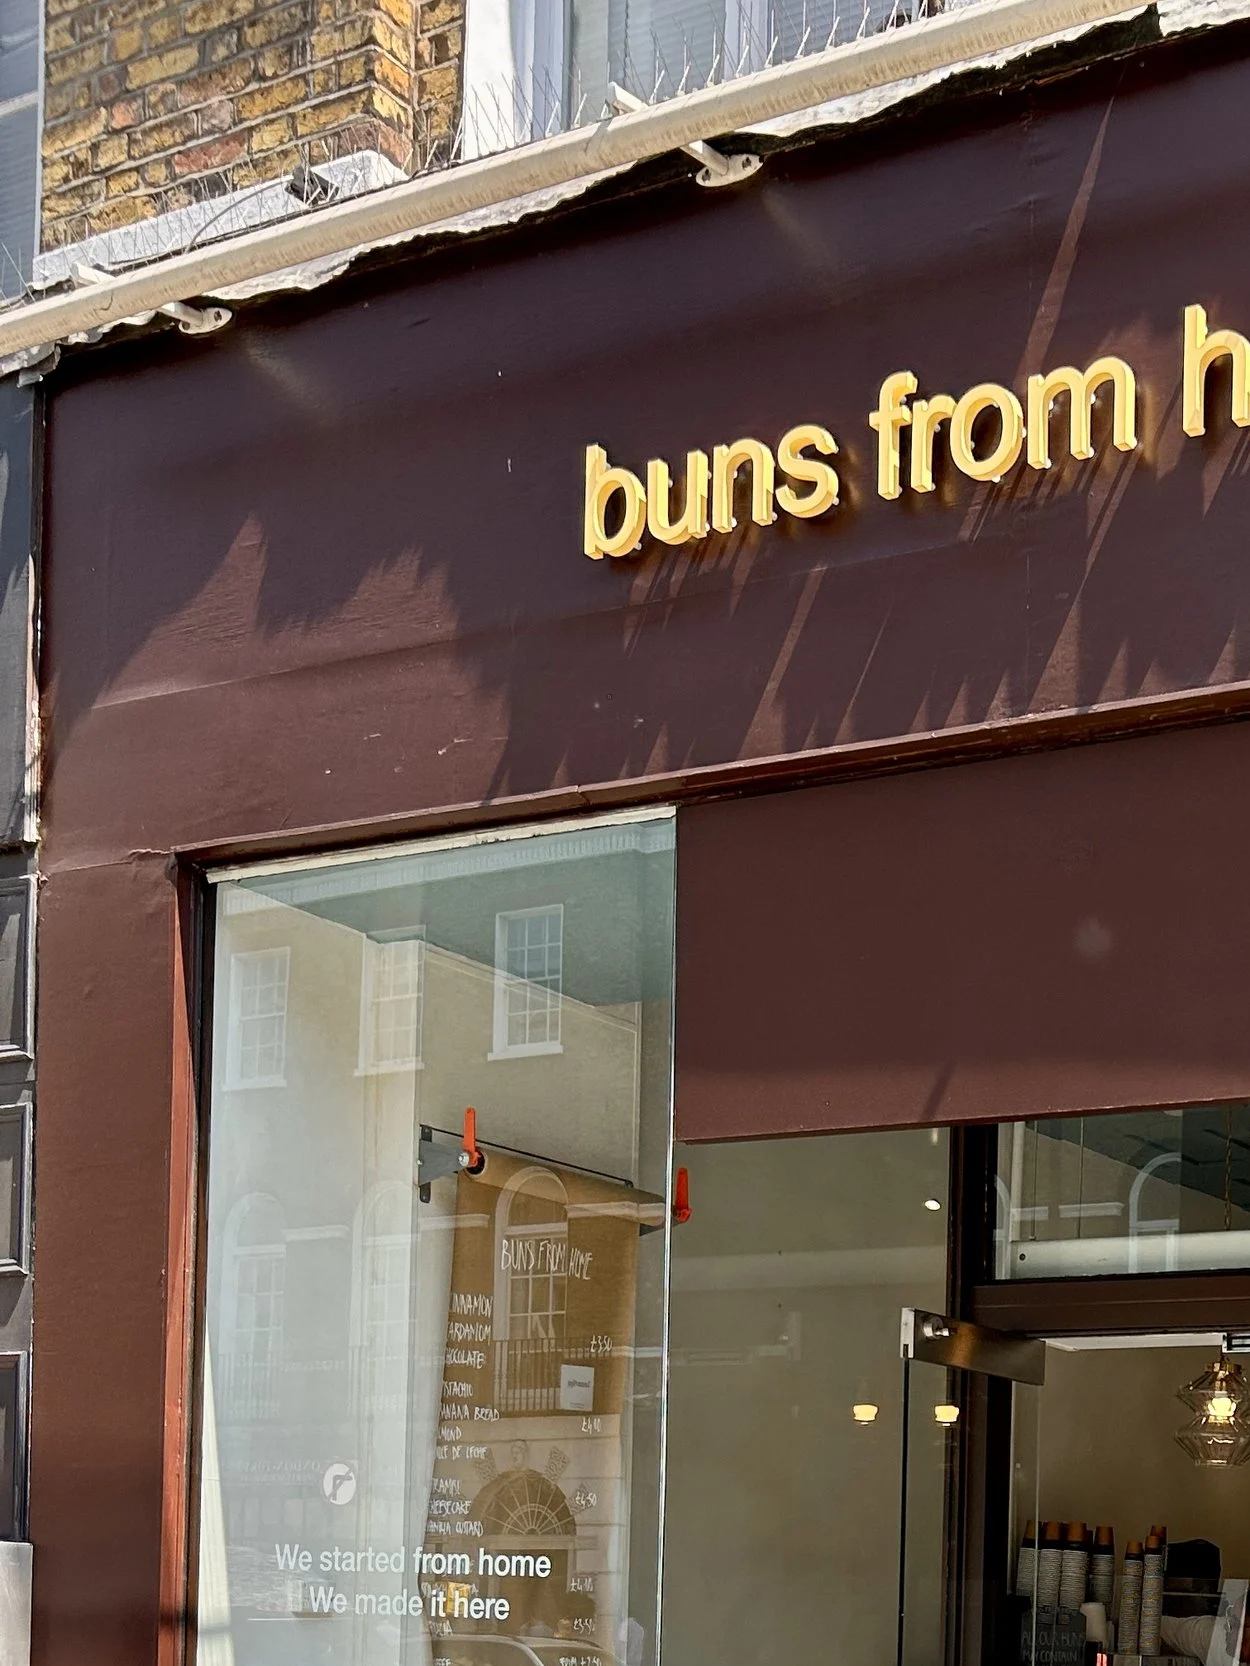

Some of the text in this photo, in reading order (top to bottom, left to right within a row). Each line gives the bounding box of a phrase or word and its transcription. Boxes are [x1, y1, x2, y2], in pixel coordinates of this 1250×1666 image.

[582, 423, 839, 560] buns
[868, 370, 1137, 500] from
[501, 1239, 593, 1280] BUNS FROM HOME
[473, 1406, 500, 1421] BREAD
[452, 1446, 463, 1461] DE
[275, 1544, 552, 1578] We started from home
[309, 1586, 510, 1620] We made it here
